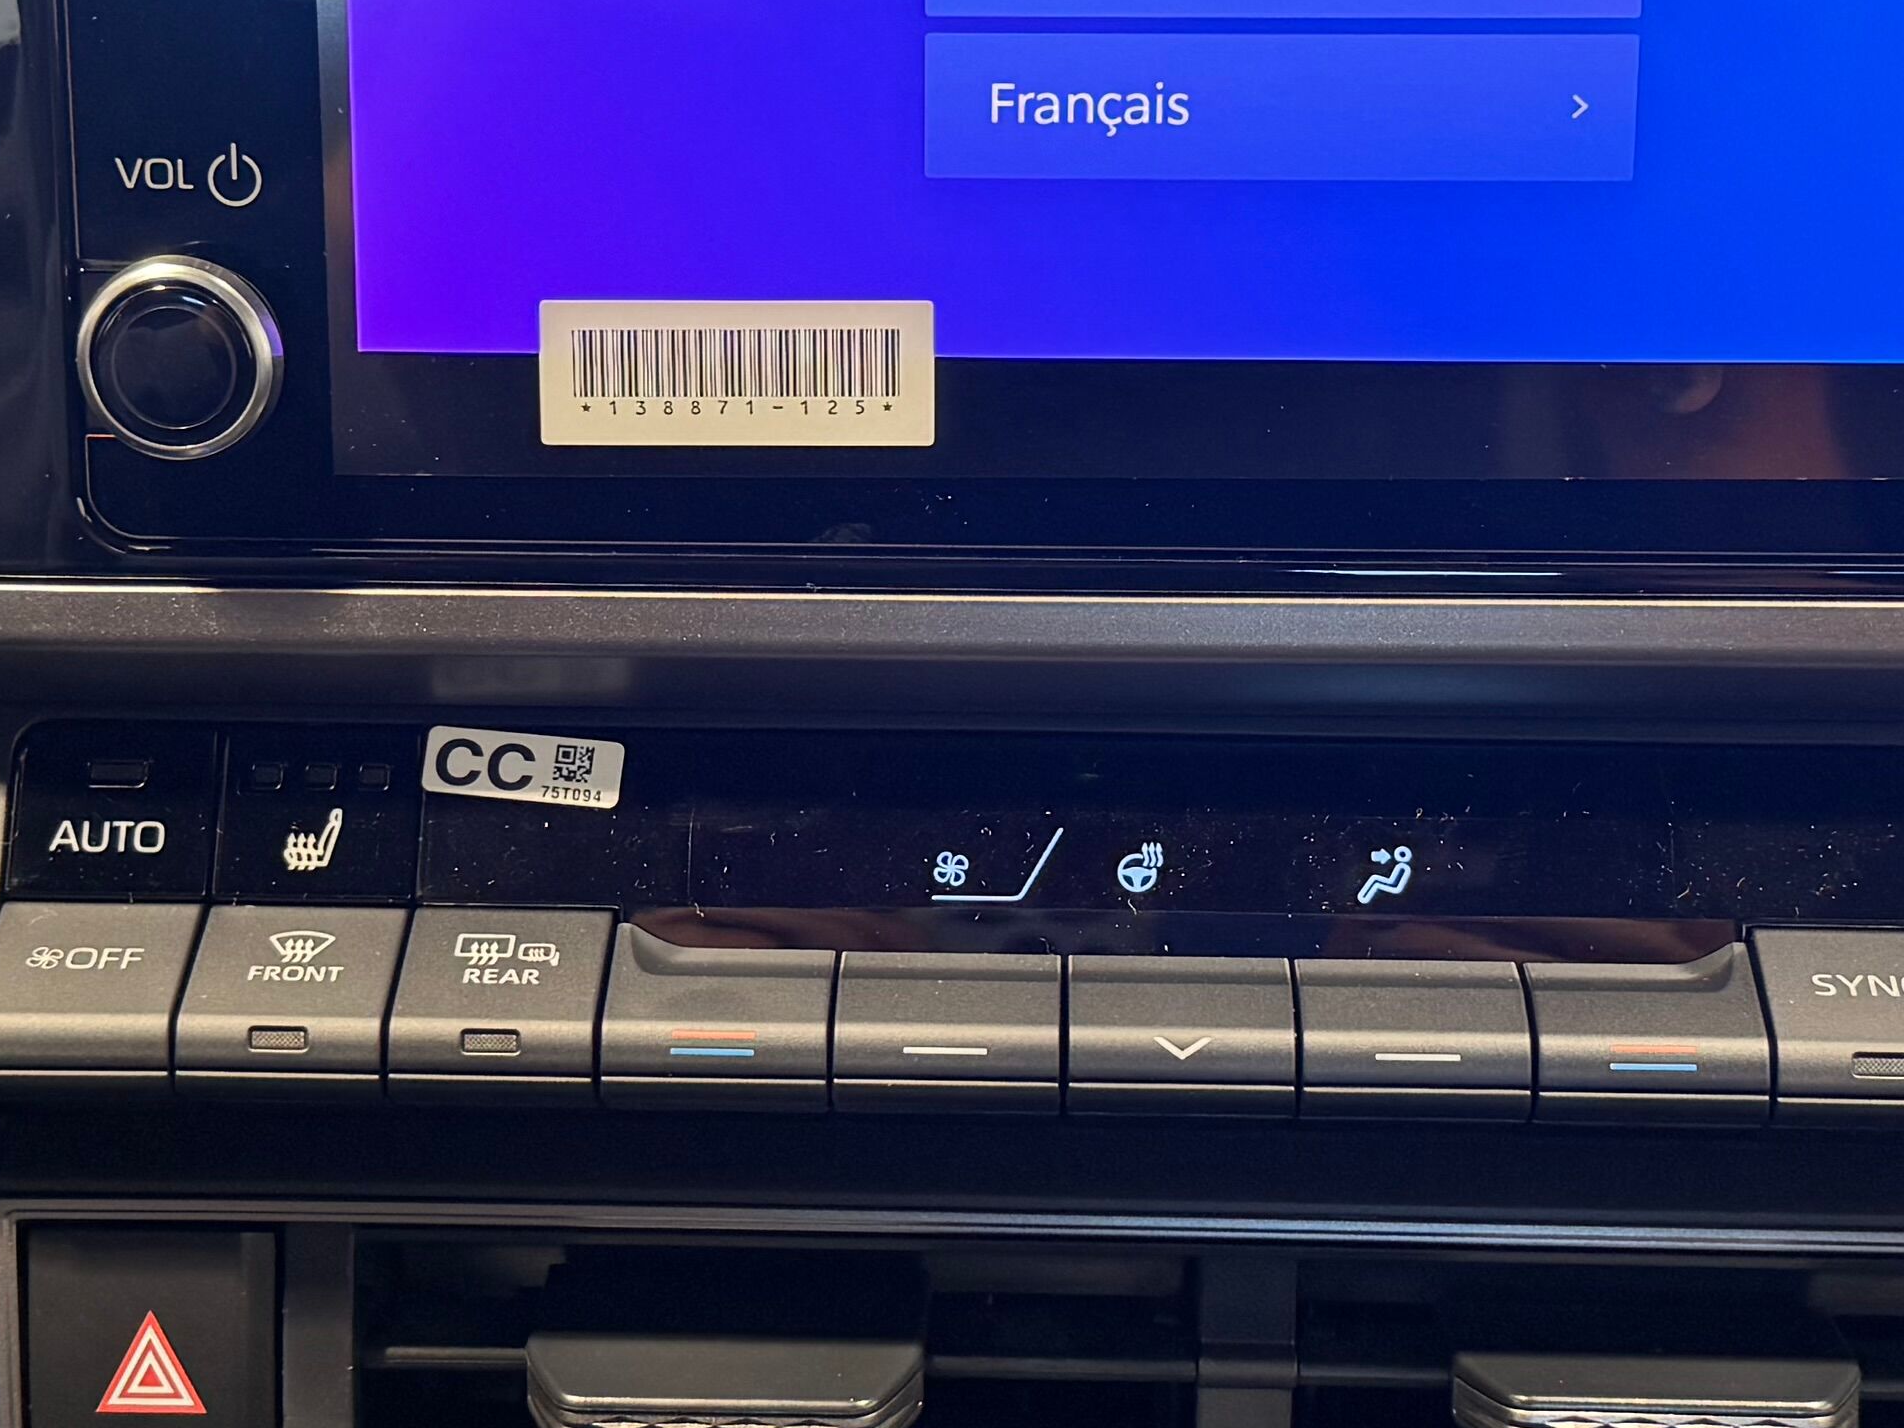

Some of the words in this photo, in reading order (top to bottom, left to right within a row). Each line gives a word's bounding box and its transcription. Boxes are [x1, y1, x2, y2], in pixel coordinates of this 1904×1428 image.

[990, 81, 1191, 137] Français
[114, 157, 195, 190] VOL
[435, 737, 537, 792] CC
[540, 784, 603, 803] 75T094
[48, 818, 167, 855] AUTO
[63, 945, 146, 972] OFF
[246, 964, 345, 984] FRONT
[461, 966, 542, 986] REAR
